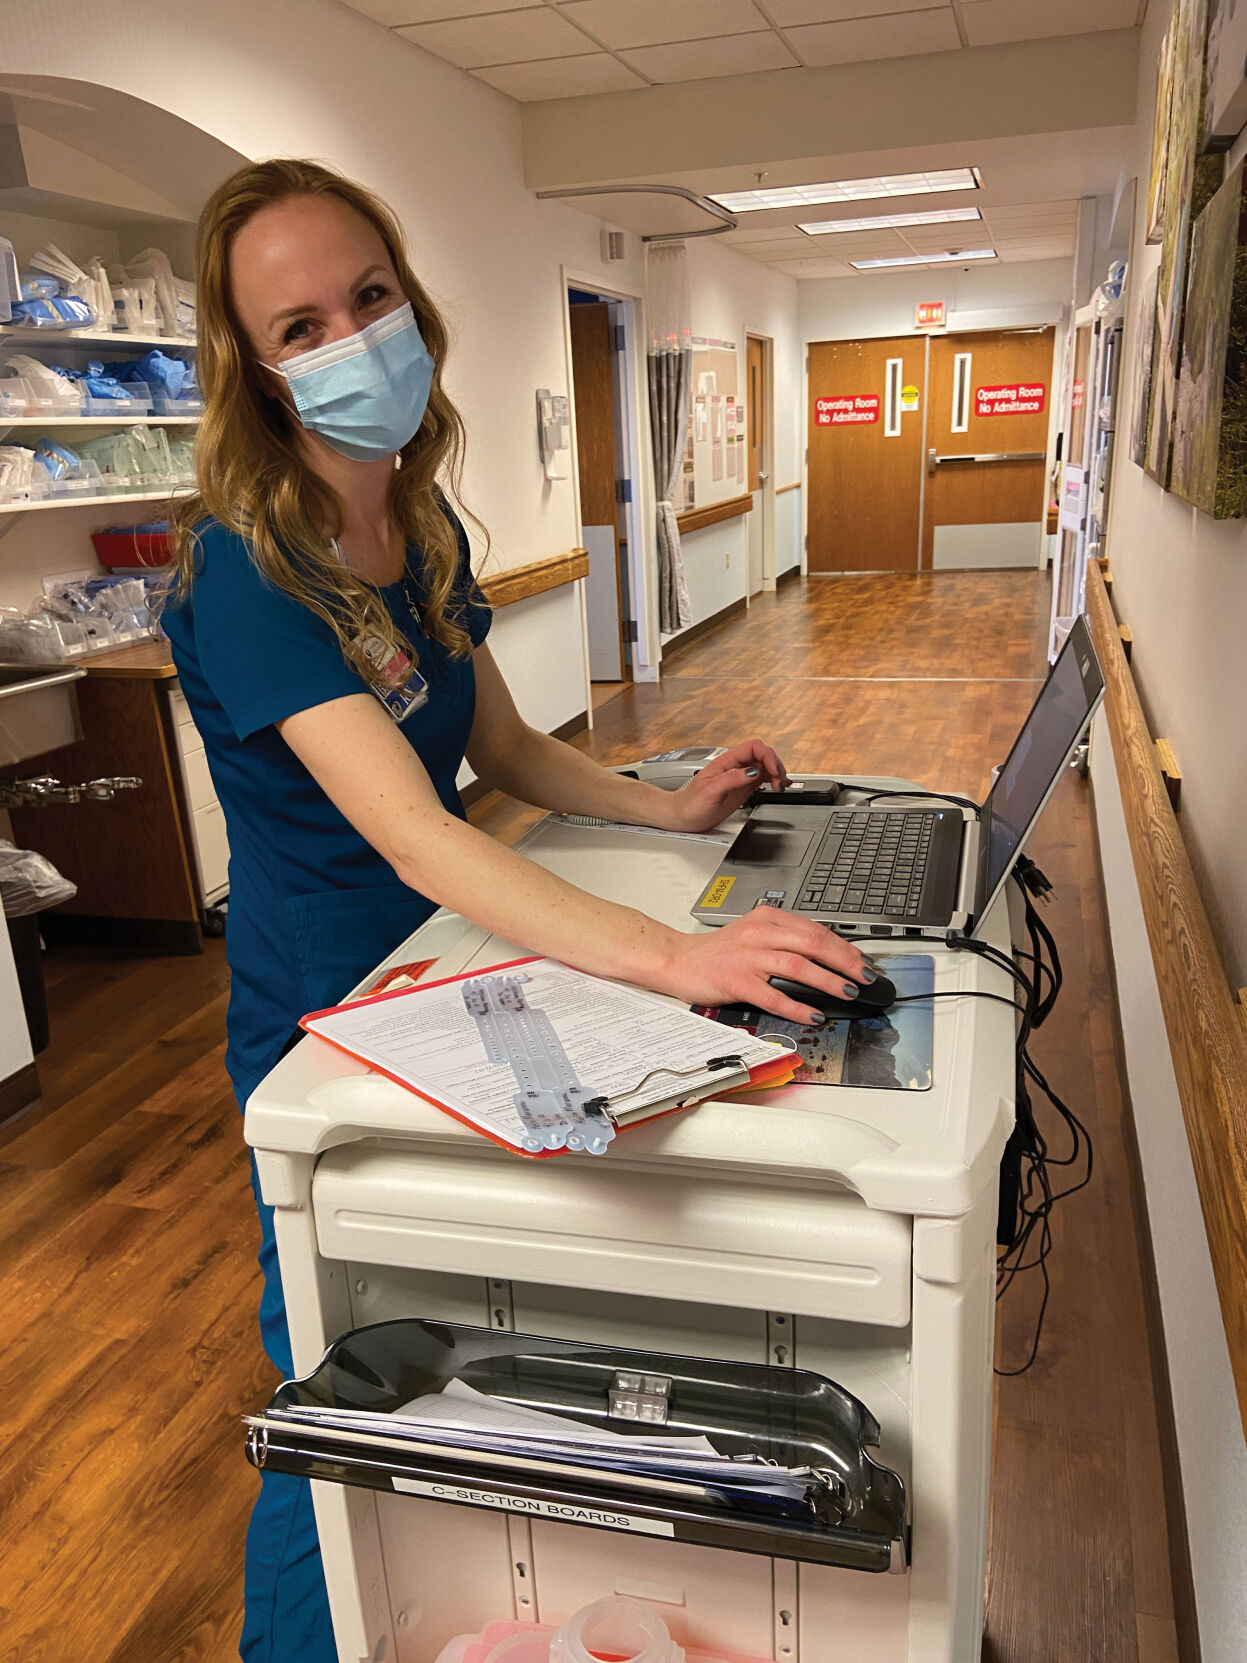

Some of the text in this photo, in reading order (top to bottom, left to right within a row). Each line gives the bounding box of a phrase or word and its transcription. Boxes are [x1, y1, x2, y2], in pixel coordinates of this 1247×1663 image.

[978, 387, 1044, 402] Operating Room
[817, 398, 878, 411] Operating Room
[979, 401, 1040, 413] No Admittance
[819, 411, 875, 423] No Admittance
[432, 1485, 631, 1527] C-SECTION BOARDS
